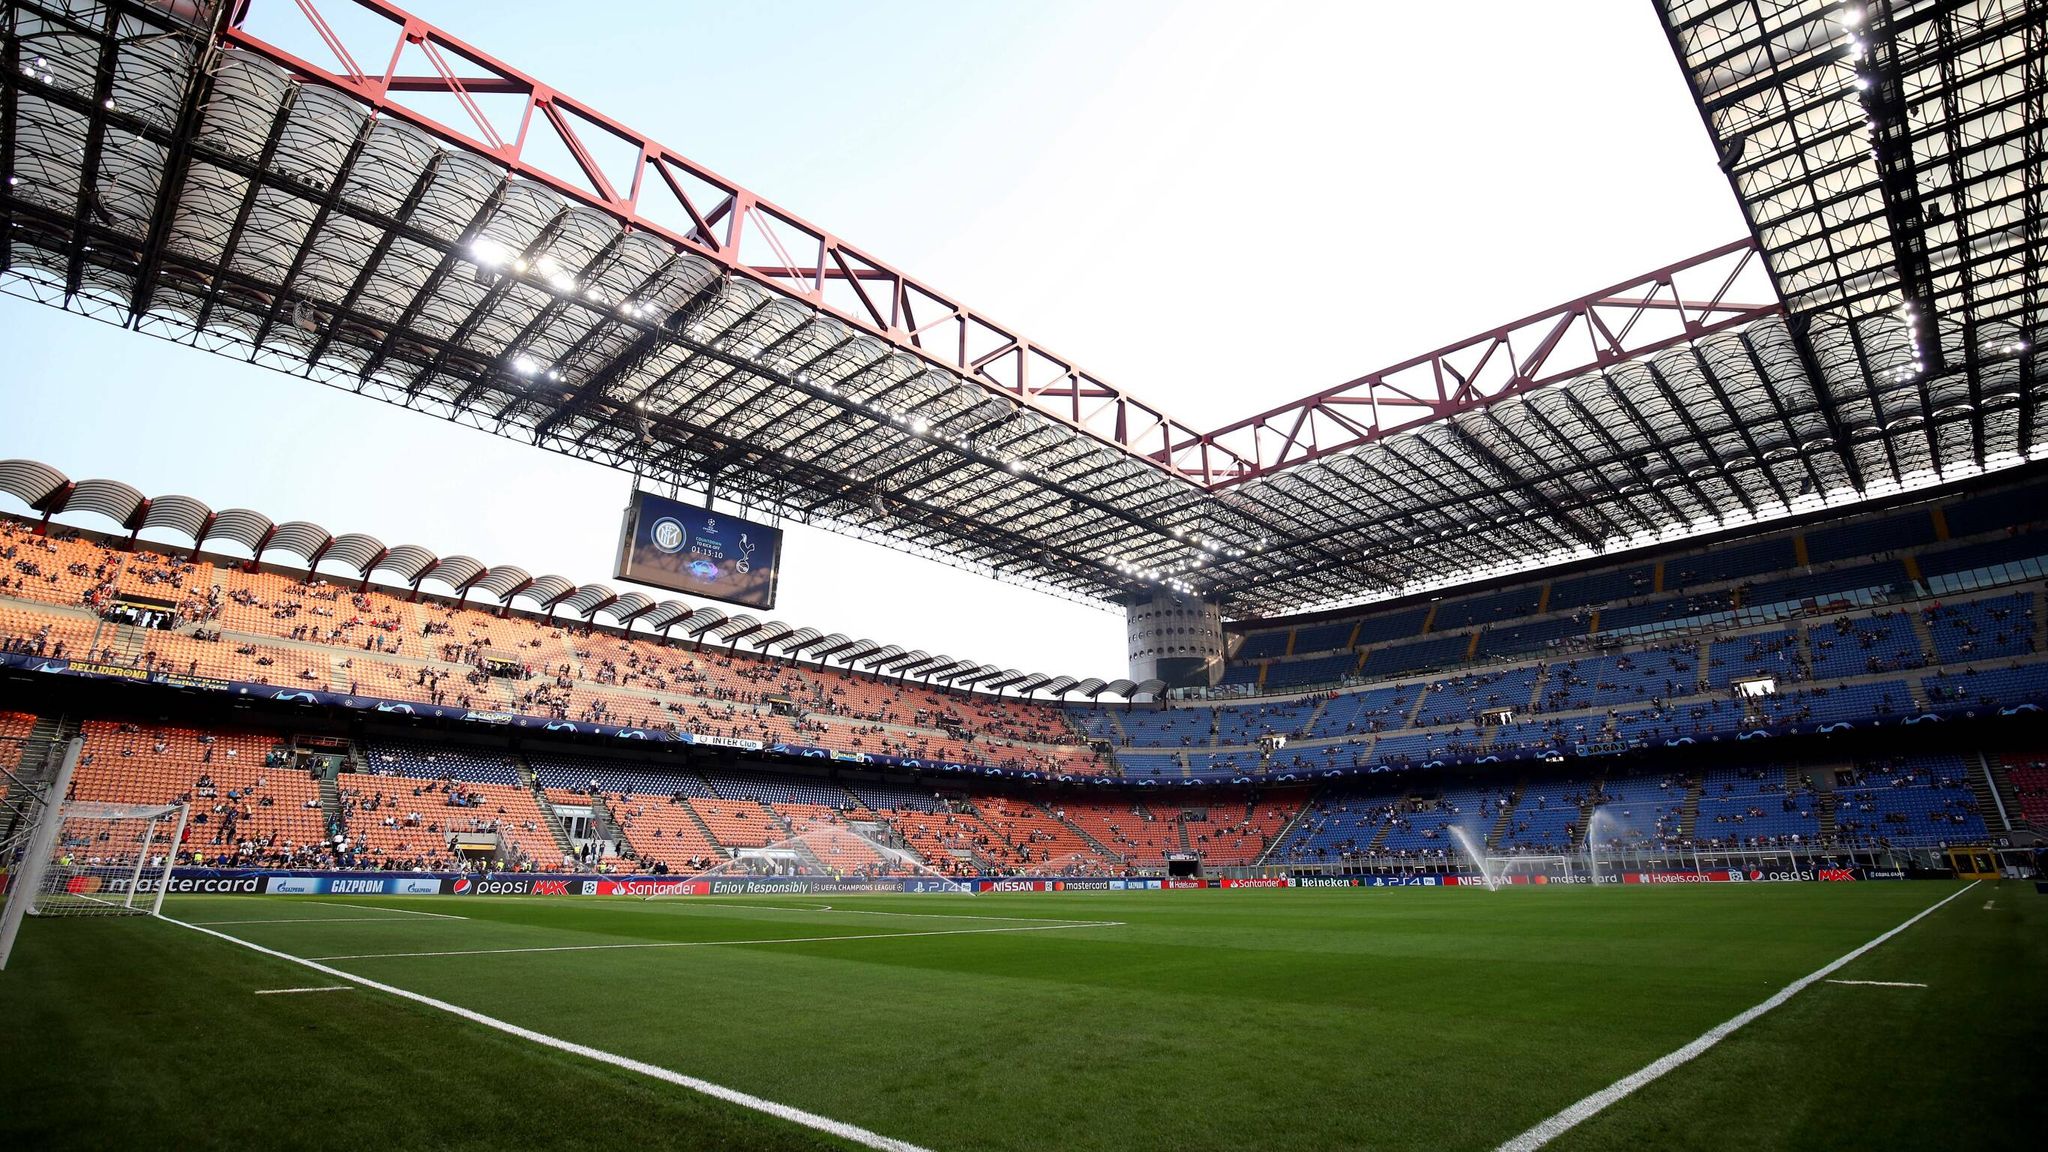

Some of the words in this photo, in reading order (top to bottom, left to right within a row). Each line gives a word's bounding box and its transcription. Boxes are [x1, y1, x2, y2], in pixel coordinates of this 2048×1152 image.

[68, 662, 148, 680] BELLIDEROMA
[712, 736, 738, 746] INTER
[739, 740, 757, 749] Club
[1550, 874, 1618, 884] mastercard
[1653, 873, 1710, 883] Hotels.com
[1818, 868, 1856, 882] MAX
[108, 876, 259, 892] mastercard
[1066, 881, 1108, 890] mastercard
[1174, 881, 1198, 889] Hotels.com
[1239, 878, 1279, 888] Santander
[1301, 878, 1350, 887] Heineken
[1388, 877, 1421, 886] PS4
[1457, 876, 1512, 886] NISSAN
[331, 880, 385, 893] GAZPROM
[476, 881, 528, 895] pepsi
[531, 880, 573, 895] MAX
[627, 882, 696, 895] Santander
[713, 882, 744, 895] Enjoy
[747, 881, 808, 894] Responsibly
[838, 884, 873, 892] CHAMPIONS
[993, 882, 1034, 892] NISSAN
